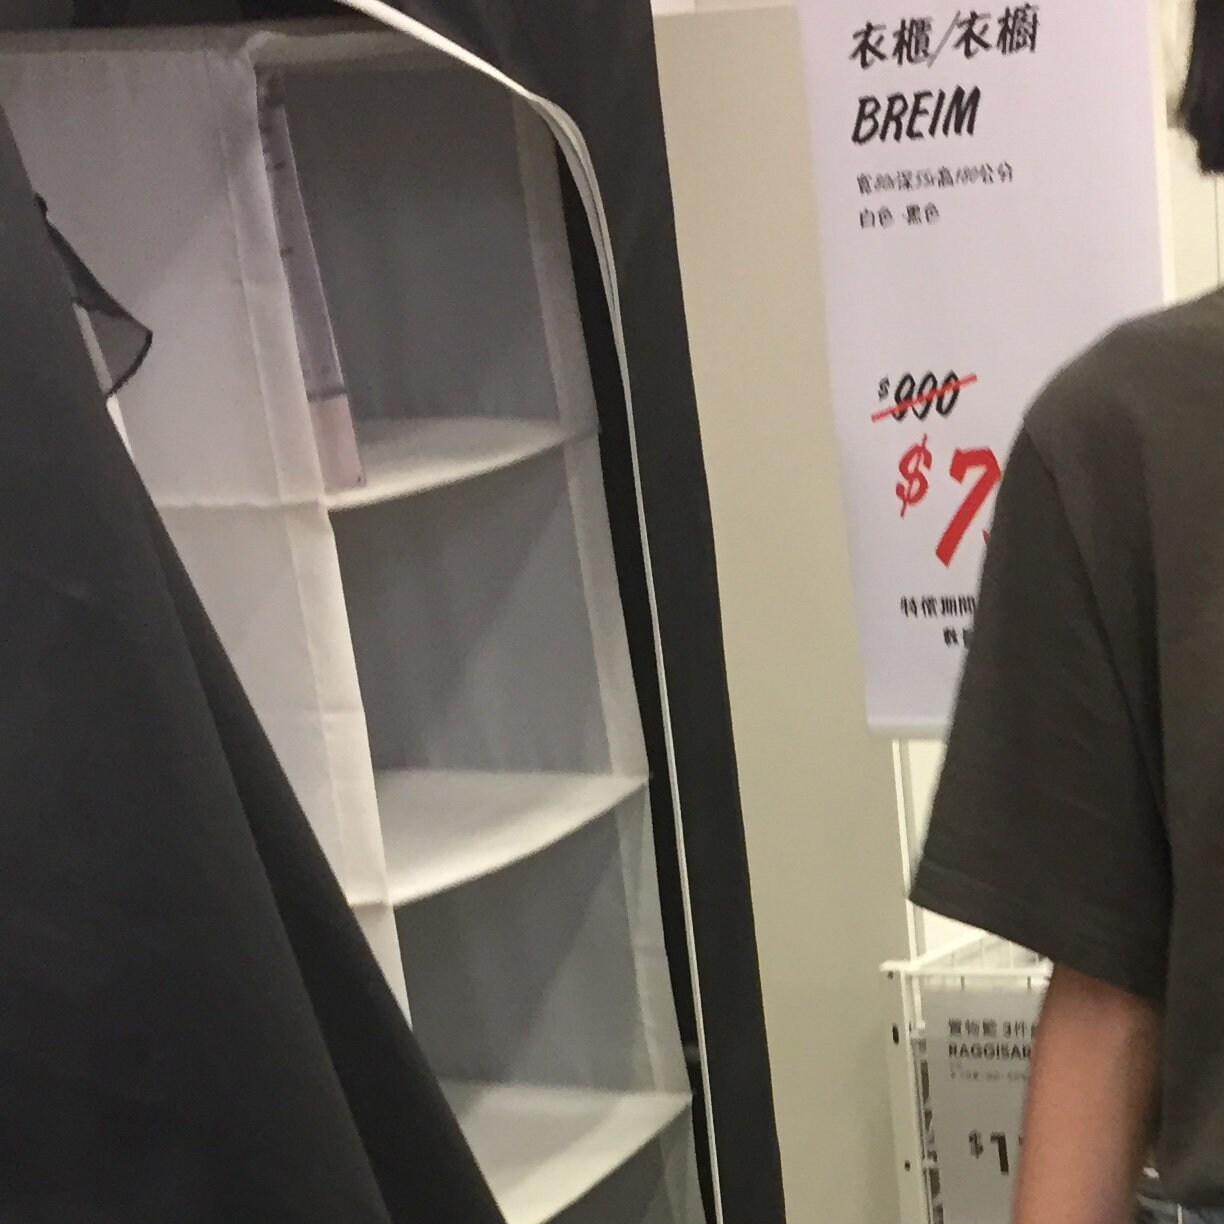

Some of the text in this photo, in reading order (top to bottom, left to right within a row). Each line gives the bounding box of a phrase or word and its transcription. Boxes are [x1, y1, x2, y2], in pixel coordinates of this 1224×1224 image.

[850, 84, 981, 145] BREIM
[877, 369, 961, 422] $990
[895, 433, 1002, 568] $7
